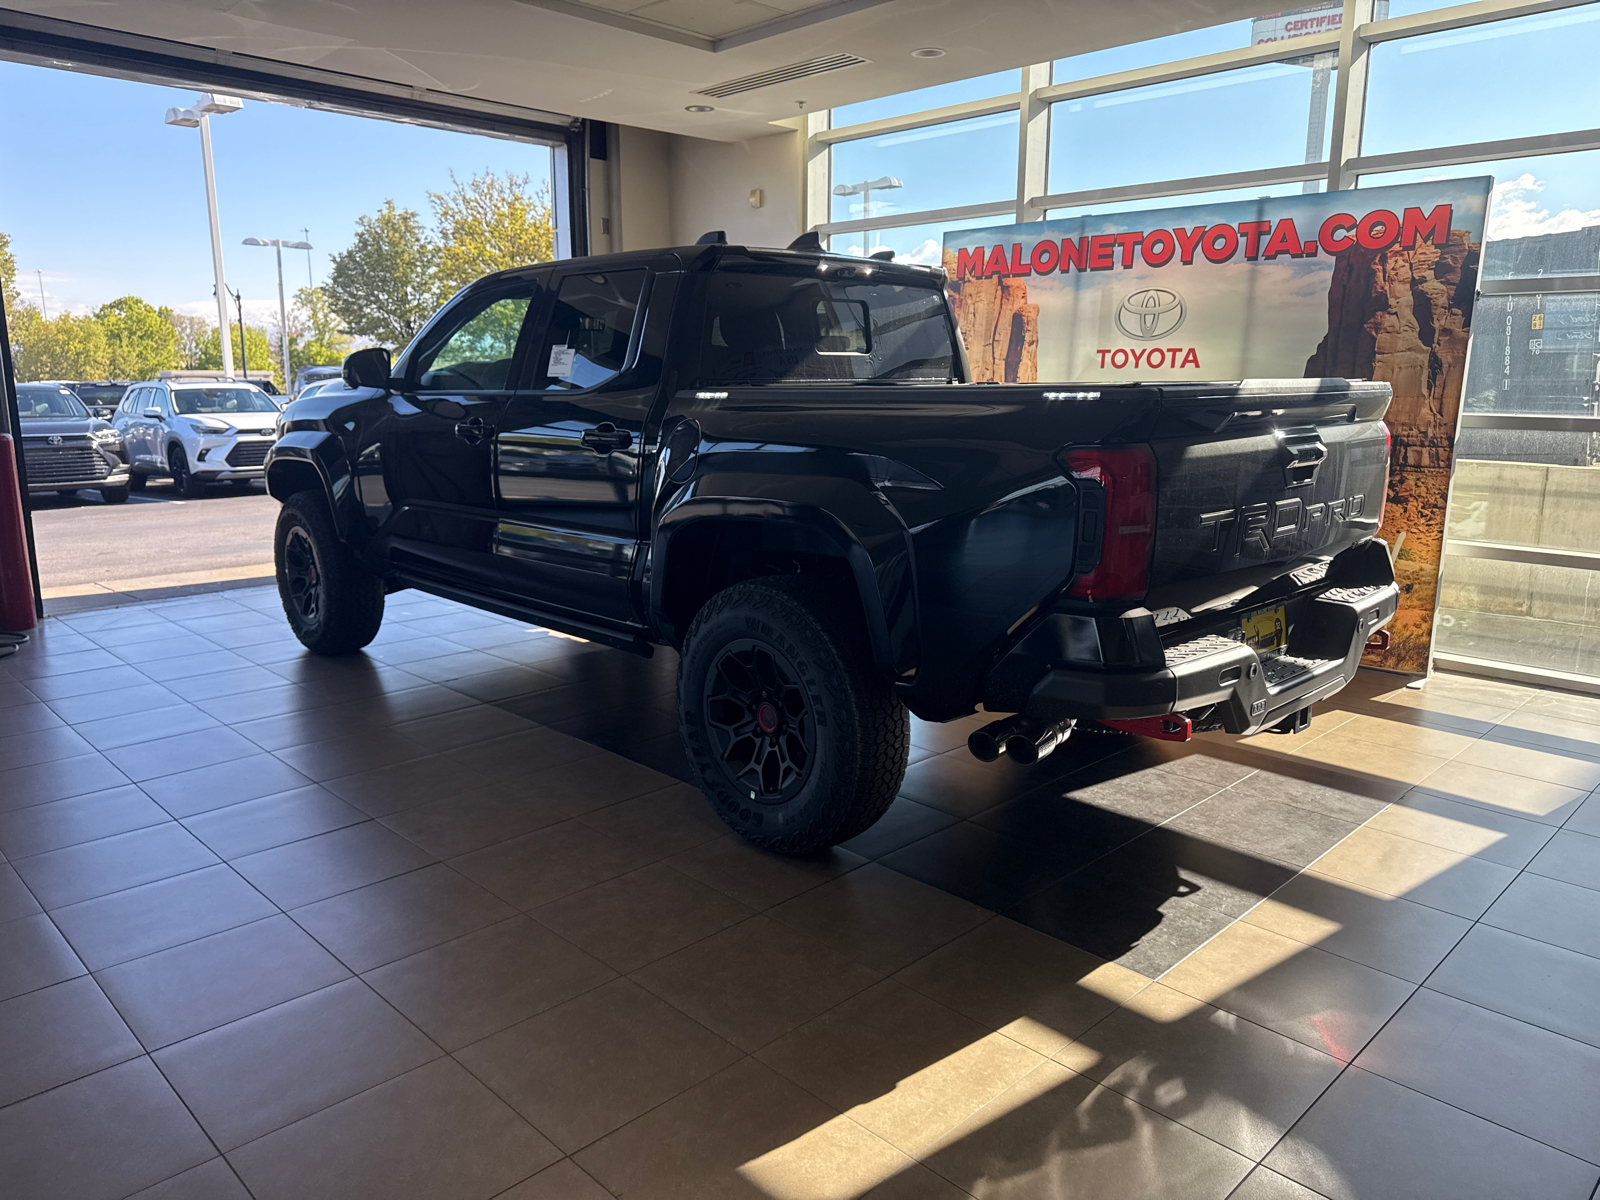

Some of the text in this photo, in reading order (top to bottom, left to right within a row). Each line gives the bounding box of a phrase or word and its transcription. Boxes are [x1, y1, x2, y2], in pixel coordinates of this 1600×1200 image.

[957, 204, 1453, 279] MALONETOYOTA.COM
[1096, 347, 1201, 370] TOYOTA
[1198, 493, 1366, 558] TRD PRO
[744, 616, 828, 729] WRANGLER
